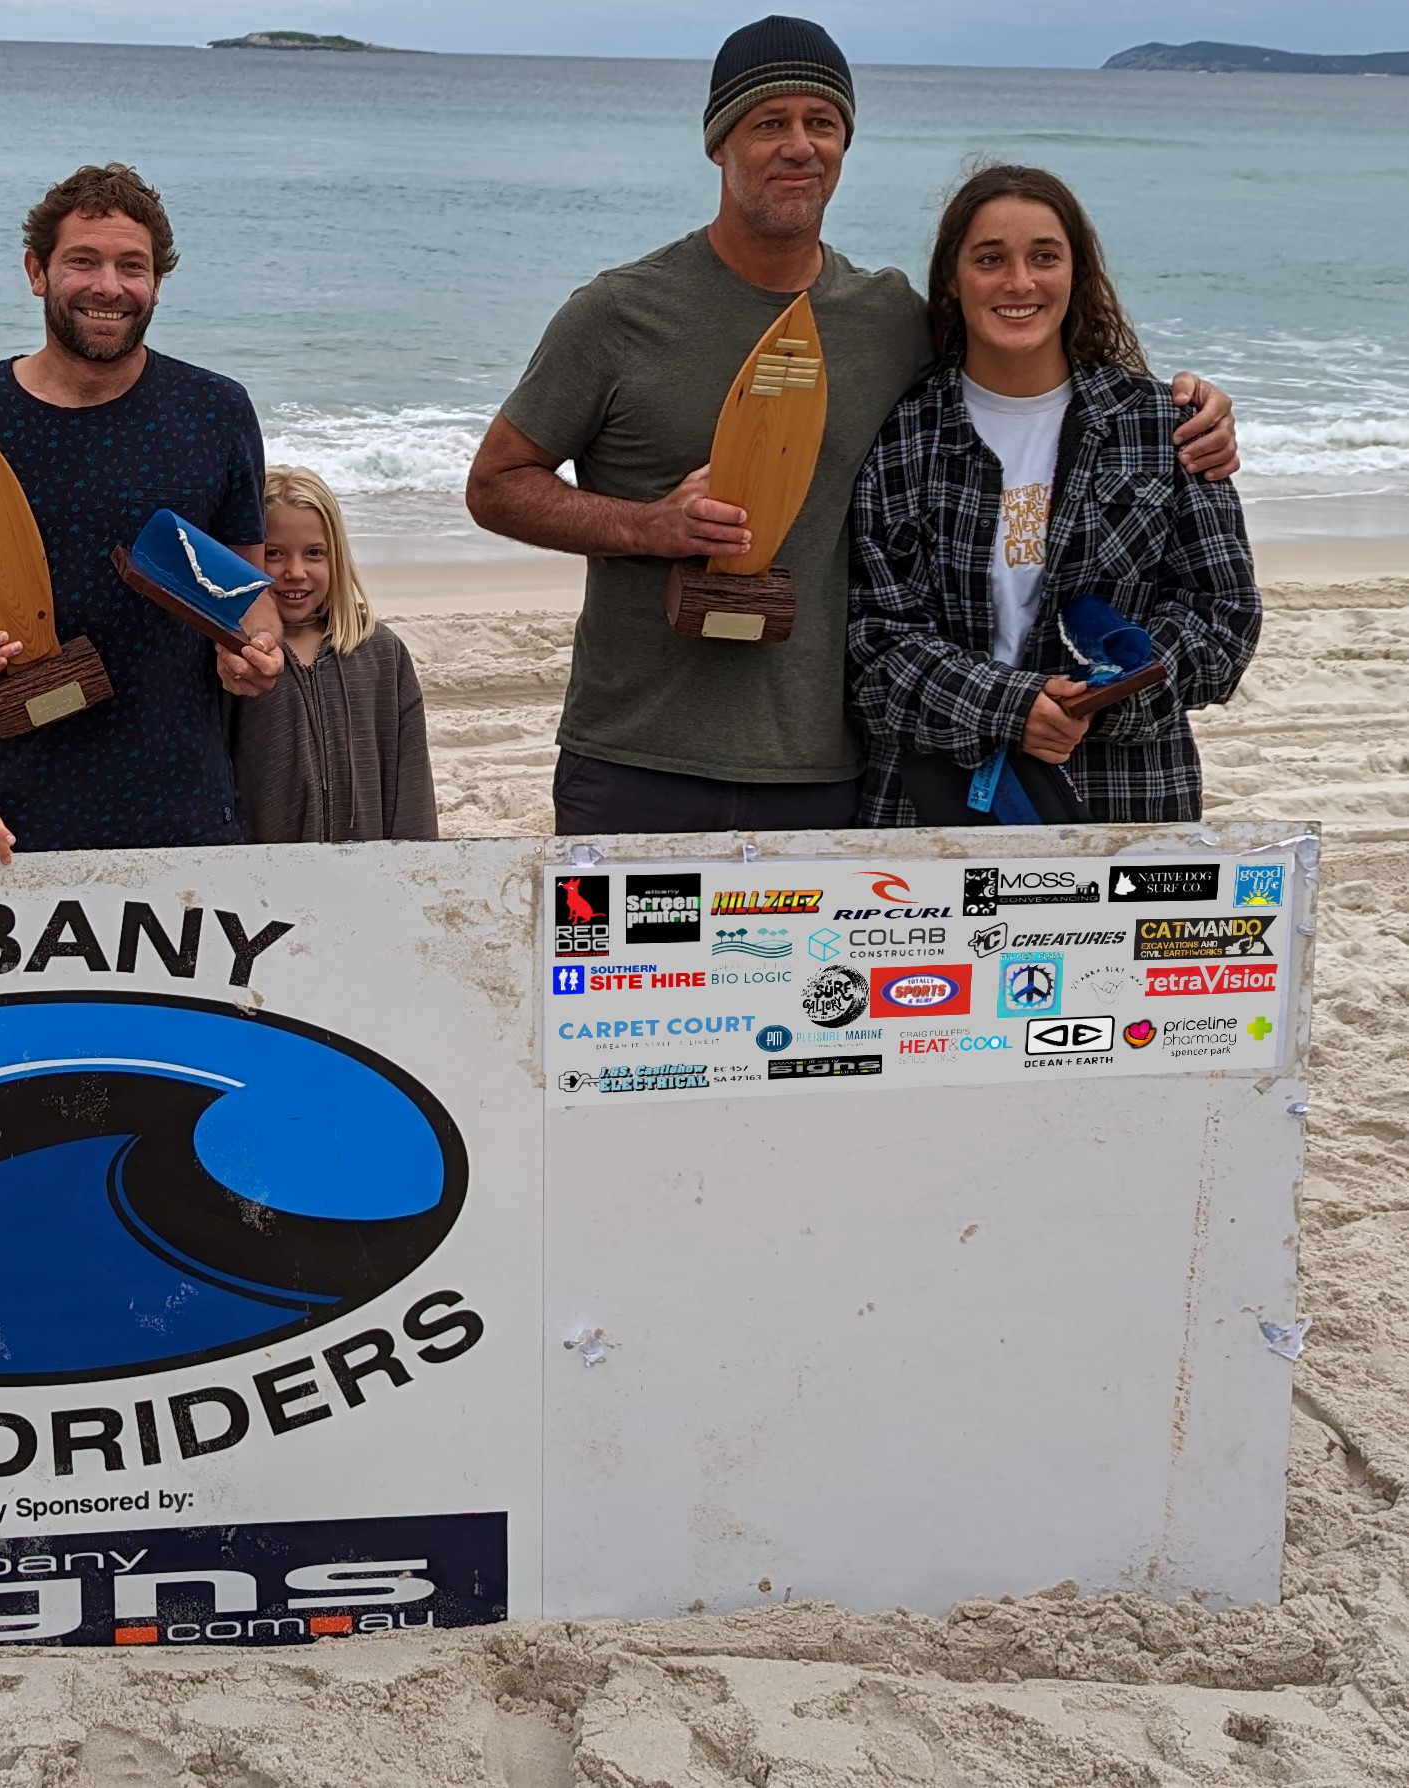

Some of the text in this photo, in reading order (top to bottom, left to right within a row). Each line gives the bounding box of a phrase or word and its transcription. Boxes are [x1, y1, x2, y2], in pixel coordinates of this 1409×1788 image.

[1000, 871, 1075, 889] MOSS
[1138, 871, 1213, 882] NATIVE DOG
[1240, 866, 1282, 881] good
[1147, 883, 1203, 893] SURF CO.
[1253, 877, 1280, 894] life
[626, 895, 699, 911] Screen
[710, 889, 823, 915] HILLZEEZ
[999, 895, 1099, 904] CONVEYANCING
[627, 910, 699, 928] printers
[833, 906, 953, 920] RIP CURL
[556, 925, 609, 939] RED
[1140, 918, 1262, 939] CATMANDO
[849, 927, 946, 946] COLAB
[1011, 931, 1127, 947] CREATURES
[556, 938, 609, 952] DOG
[1141, 940, 1218, 950] EXCAVATIONS AND
[849, 948, 945, 959] CONSTRUCTION
[1140, 948, 1223, 958] CIVIL EARTHWORKS
[590, 965, 657, 975] SOUTHERN
[590, 972, 706, 991] SITE HIRE
[711, 971, 792, 985] BIO LOGIC
[814, 980, 854, 1001] SURF
[894, 984, 947, 999] SPORTS
[558, 1015, 756, 1040] CARPET COURT
[899, 1028, 971, 1039] CRAIG FULLER'S
[1163, 1016, 1238, 1036] priceline
[766, 1031, 783, 1047] PM
[845, 1028, 883, 1040] MARINE
[1162, 1033, 1237, 1049] pharmacy
[1170, 1046, 1231, 1058] spencer park
[770, 1060, 881, 1074] signs
[1024, 1058, 1063, 1068] OCEAN
[1076, 1056, 1114, 1065] EARTH
[635, 1063, 708, 1077] Castlehow
[599, 1074, 710, 1093] ELECTRICAL
[15, 1490, 150, 1521] Sponsored
[158, 1488, 195, 1511] by:
